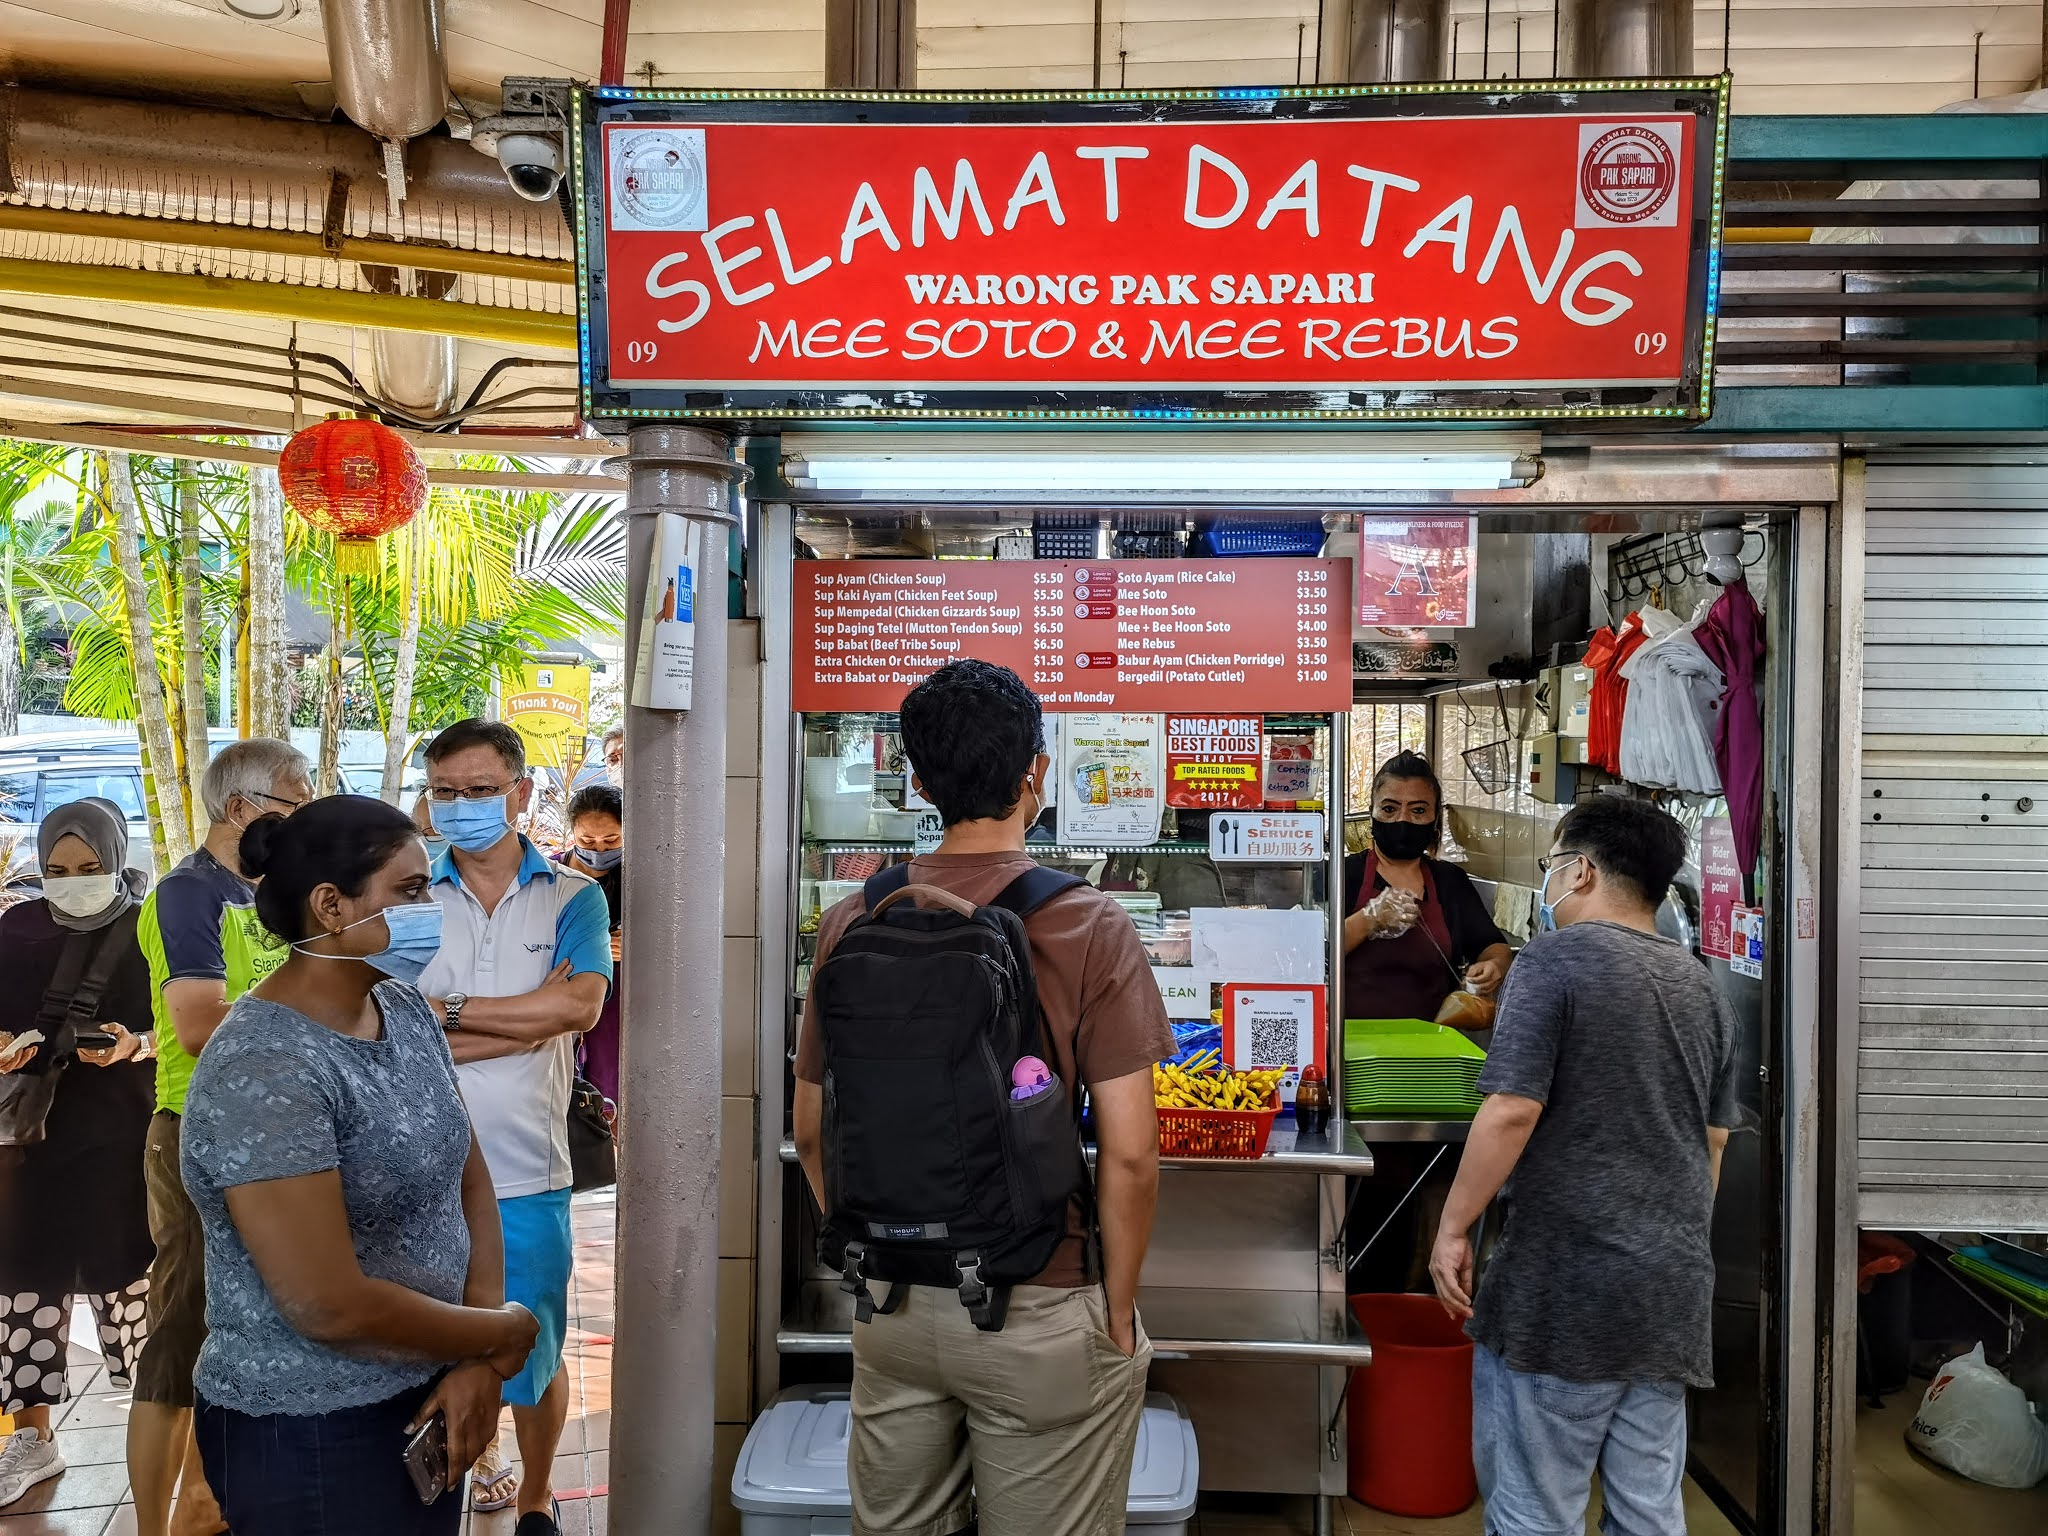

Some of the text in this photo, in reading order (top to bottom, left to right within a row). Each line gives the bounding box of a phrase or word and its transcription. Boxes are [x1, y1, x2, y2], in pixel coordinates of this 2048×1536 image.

[1592, 129, 1667, 153] SELAMAT DATANG
[652, 172, 684, 190] SAPARI
[1600, 166, 1655, 185] PAK SAPARI
[645, 143, 1643, 333] SELAMAT DATANG
[905, 272, 1375, 305] WARONG PAK SAPARI
[748, 316, 1519, 364] MEE SOTO & MEE REBUS
[1633, 332, 1668, 356] 09
[627, 340, 658, 364] 09
[1384, 543, 1440, 596] A
[815, 572, 1063, 587] Sup Ayam (Chicken Soup) $5.50
[1118, 570, 1327, 586] Soto Ayam (Rice Cake) $3.50
[815, 589, 1063, 603] Sup Kaki Ayam (Chicken Feet Soup) $5.50
[1118, 587, 1327, 600] Mee Soto $3.50
[815, 605, 1063, 620] Sup Mempedal (Chicken Gizzards Soup) $5.50
[1118, 603, 1327, 616] Bee Hoon Soto $3.50
[815, 622, 1063, 636] Sup Daging Tetel (Mutton Tendon Soup) $6.50
[1118, 620, 1327, 633] Mee + Bee Hoon Soto $4.00
[815, 638, 1063, 652] Sup Babat (Beef Tribe Soup) $6.50
[1118, 636, 1327, 649] Mee Rebus $3.50
[815, 656, 842, 667] Extra
[845, 655, 886, 667] Chicken
[889, 655, 901, 667] Or
[904, 655, 944, 667] Chicken
[1034, 655, 1063, 666] $1.50
[1118, 653, 1327, 668] Bubur Ayam (Chicken Porridge) $3.50
[815, 672, 842, 683] Extra
[846, 672, 876, 683] Babat
[879, 674, 890, 683] or
[1034, 671, 1063, 683] $2.50
[1118, 670, 1327, 684] Bergedil (Potato Cutlet) $1.00
[511, 696, 578, 714] Thank You!
[1059, 693, 1071, 703] on
[1074, 691, 1115, 705] Monday
[516, 723, 542, 739] RETURNING
[1169, 719, 1259, 736] SINGAPORE
[1073, 738, 1105, 748] Warong
[1106, 738, 1122, 747] Pak
[1171, 737, 1256, 751] BEST FOODS
[1195, 755, 1233, 763] ENJOY
[1182, 766, 1195, 774] TOP
[1222, 767, 1245, 775] FOODS
[1201, 792, 1229, 802] 2017
[1261, 818, 1300, 828] SELF
[1247, 828, 1314, 839] SERVICE
[1247, 841, 1315, 856] 自助服务
[1712, 845, 1730, 859] Rider
[1705, 862, 1736, 877] collection
[1711, 880, 1729, 895] point
